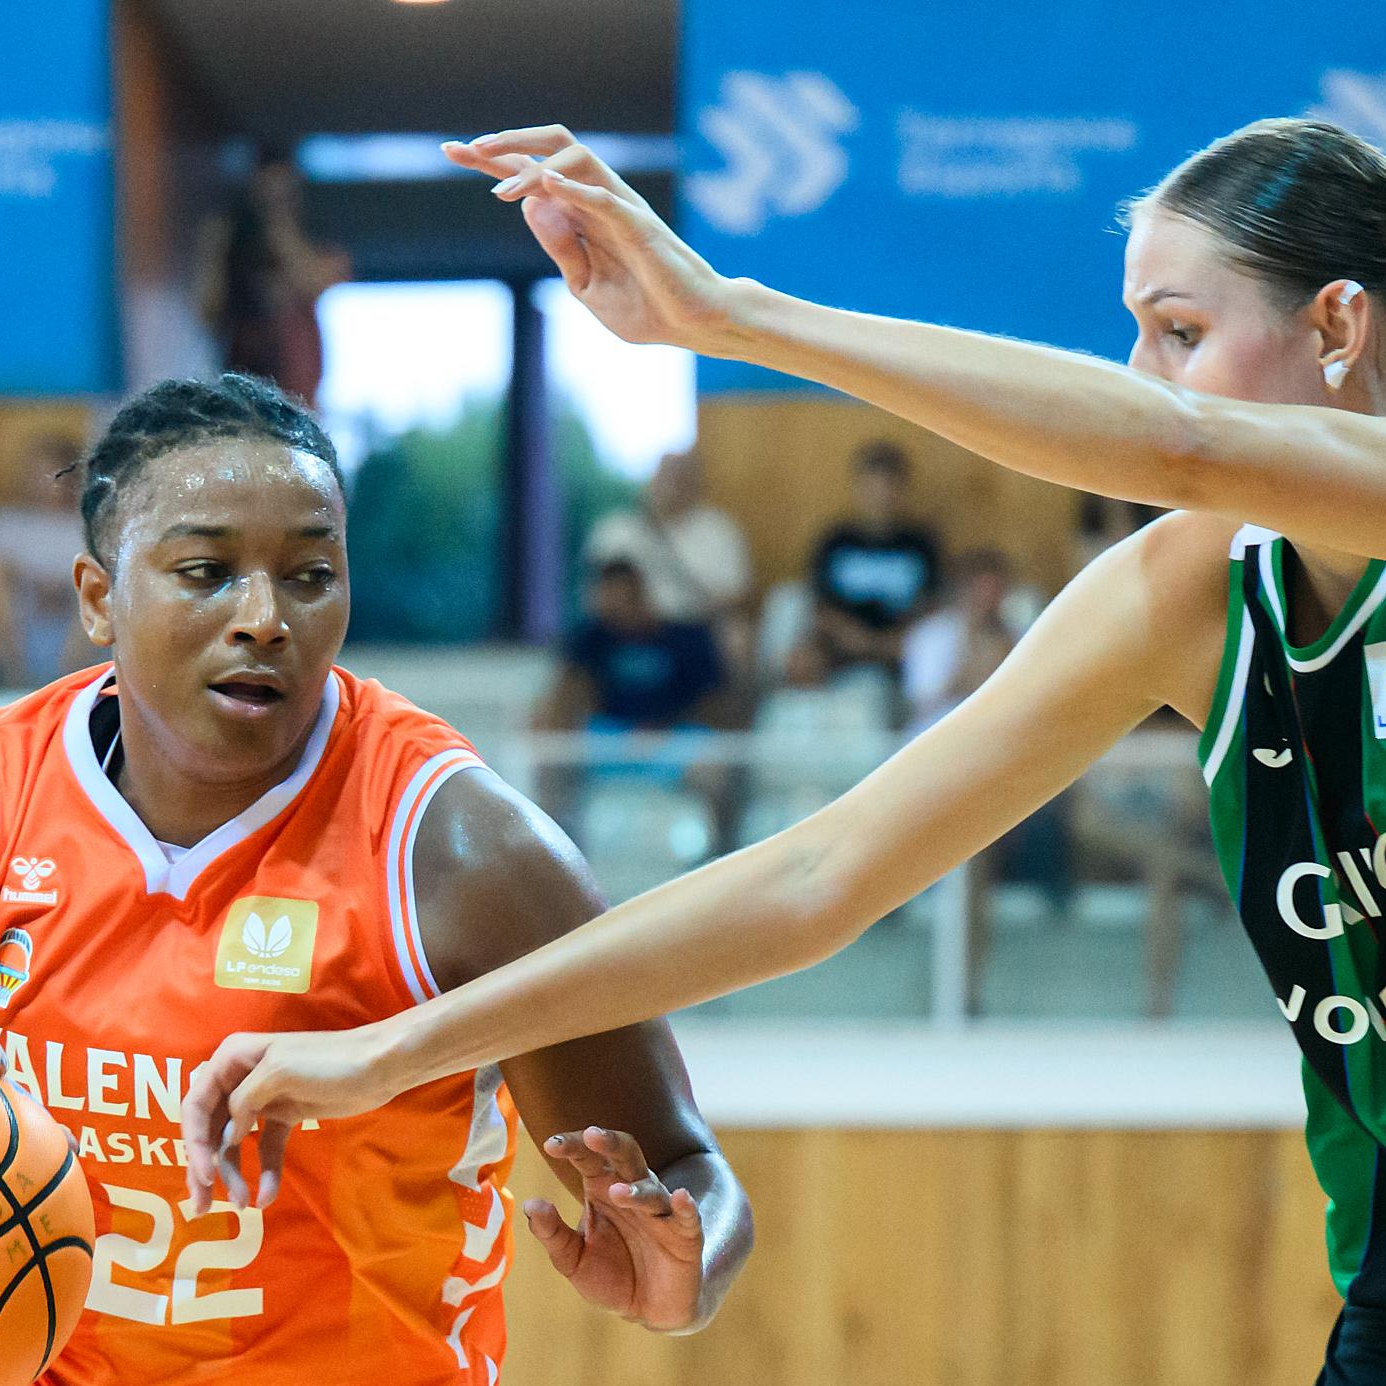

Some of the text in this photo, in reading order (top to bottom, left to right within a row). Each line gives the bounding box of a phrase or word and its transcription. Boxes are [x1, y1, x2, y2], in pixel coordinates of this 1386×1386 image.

[226, 960, 301, 977] LF endesa
[84, 1182, 264, 1327] 22
